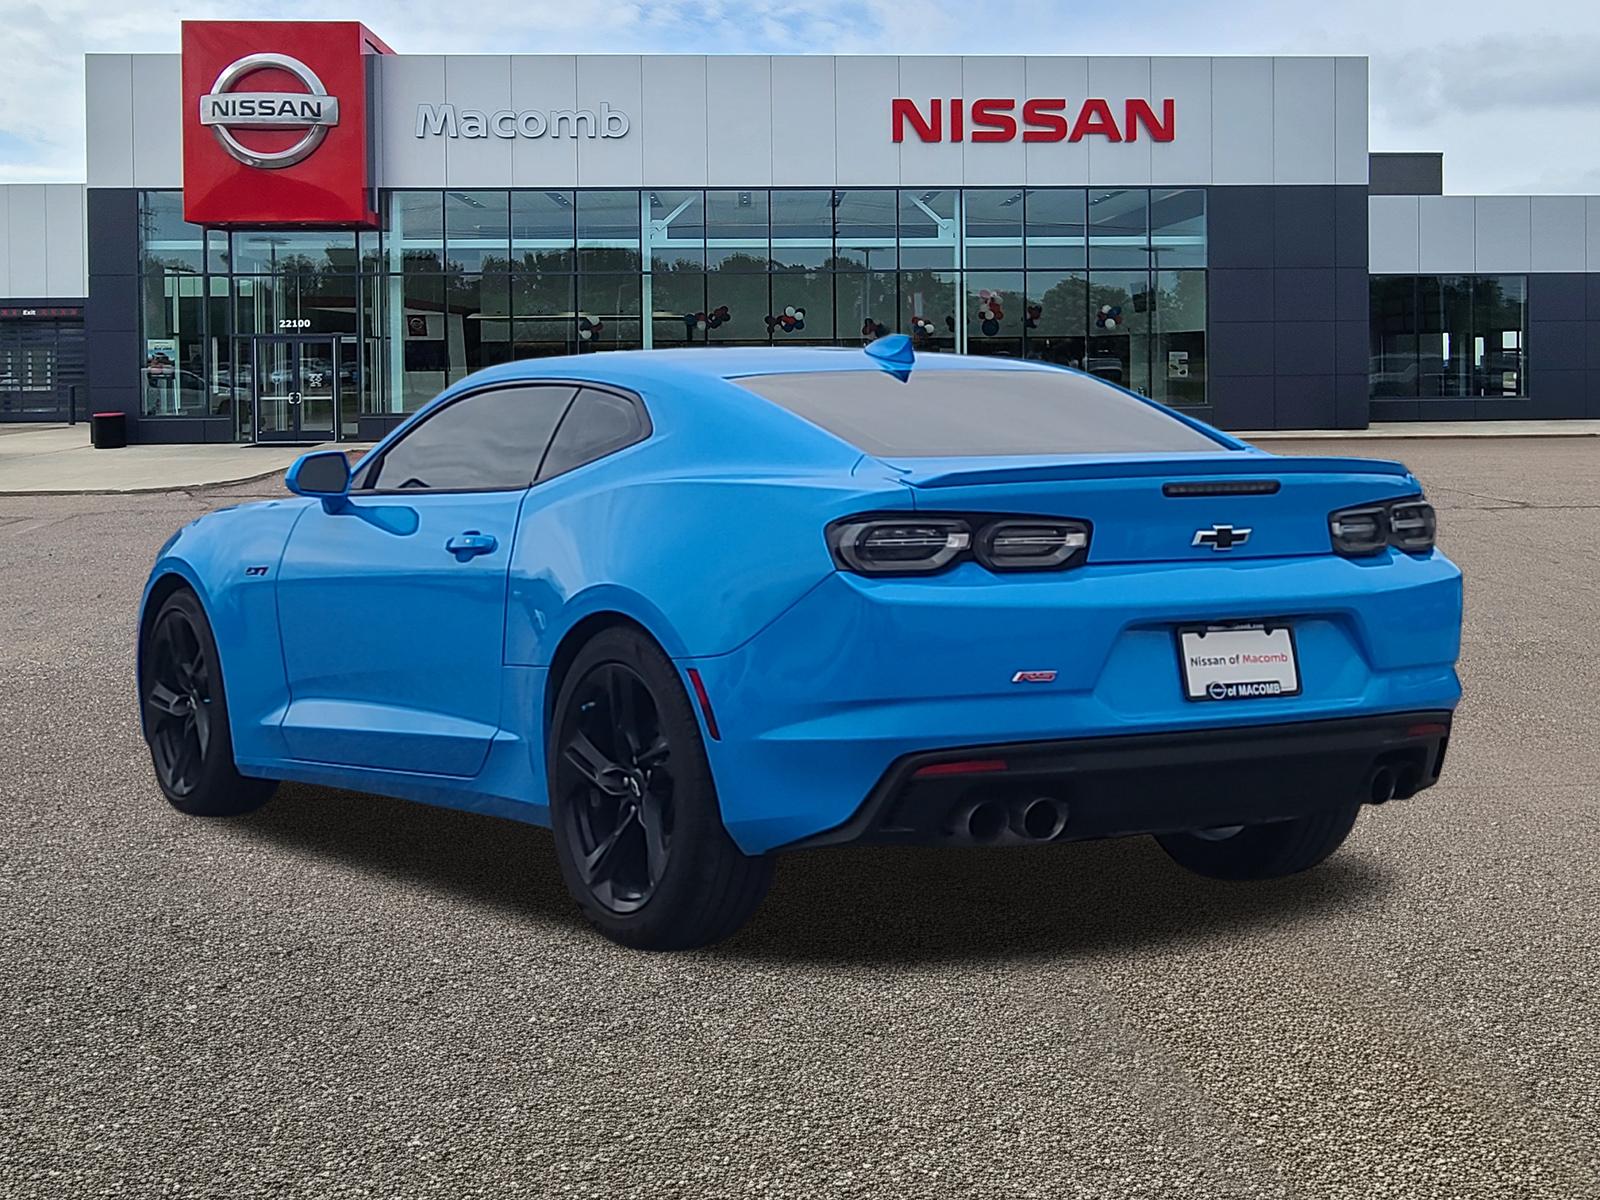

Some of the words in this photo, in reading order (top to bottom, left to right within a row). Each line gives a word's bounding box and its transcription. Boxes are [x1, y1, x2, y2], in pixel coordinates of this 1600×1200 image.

[212, 100, 321, 117] NISSAN
[415, 101, 630, 139] Macomb
[891, 98, 1175, 143] NISSAN
[279, 319, 311, 328] 22100
[1190, 657, 1226, 667] Nissan
[1229, 654, 1240, 664] of
[1242, 653, 1288, 664] Macomb
[1012, 670, 1057, 682] RS
[1239, 683, 1281, 696] MACOMB
